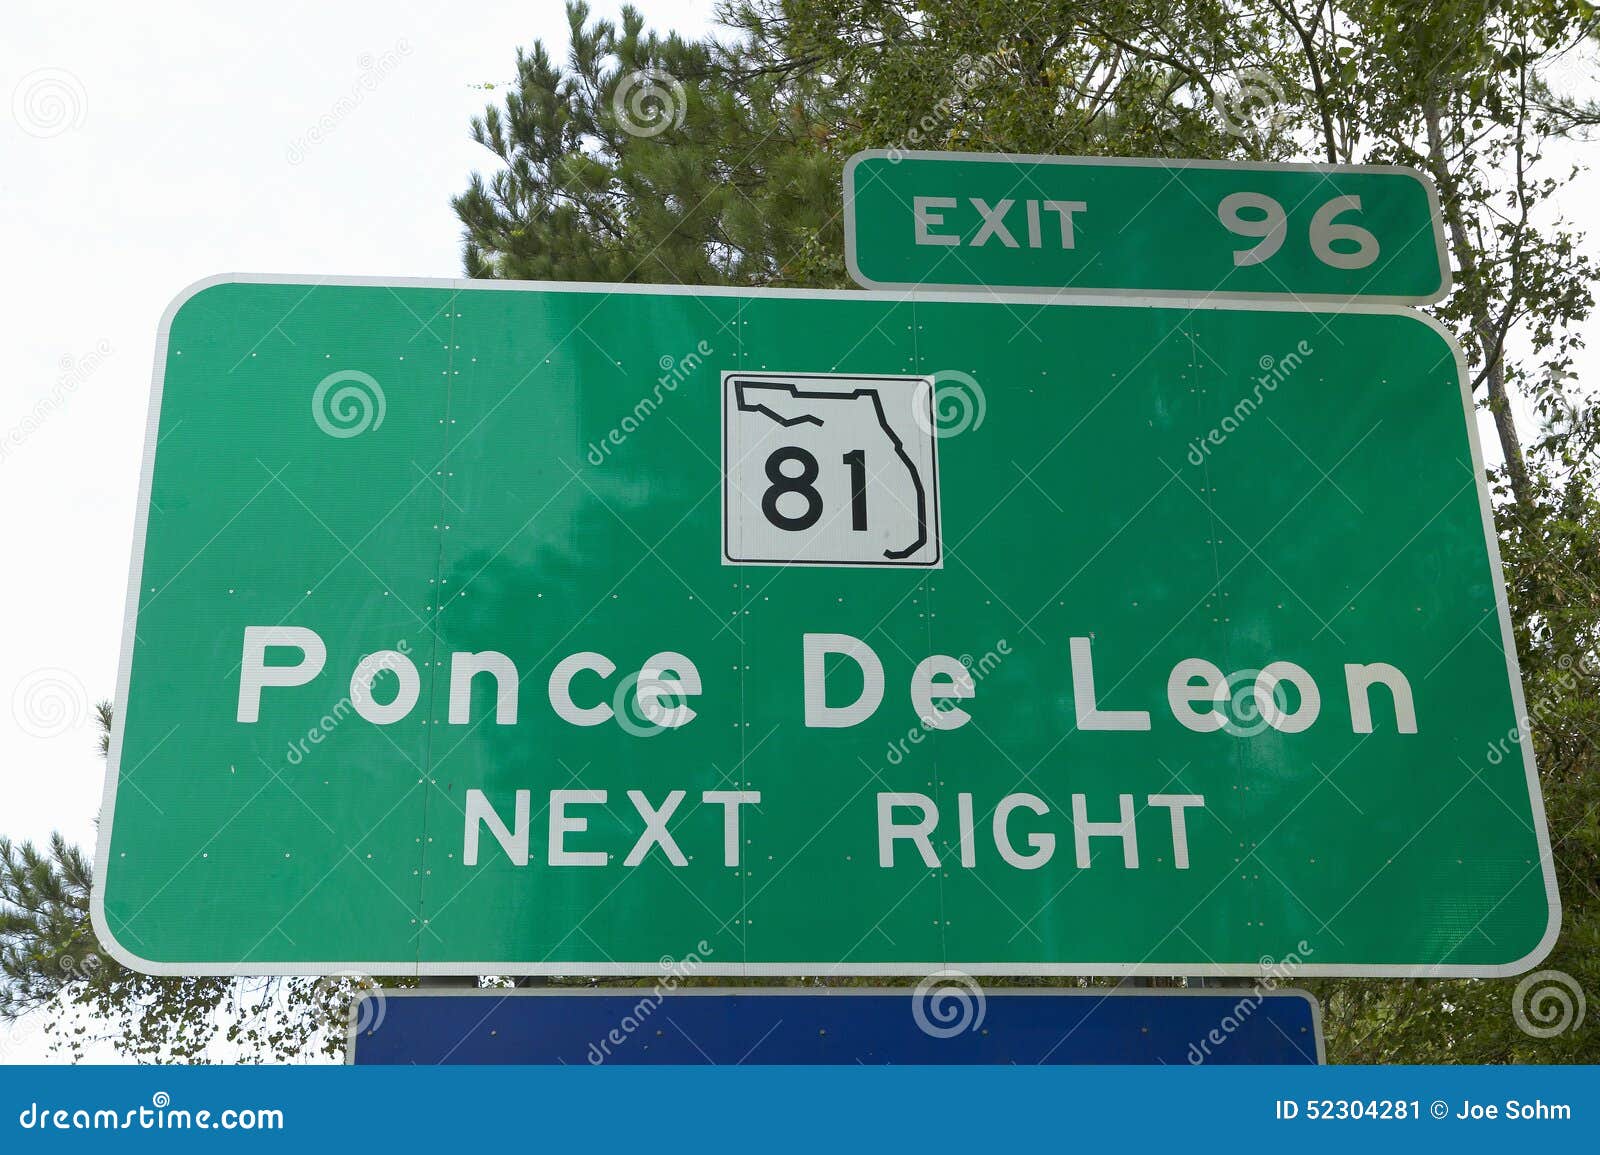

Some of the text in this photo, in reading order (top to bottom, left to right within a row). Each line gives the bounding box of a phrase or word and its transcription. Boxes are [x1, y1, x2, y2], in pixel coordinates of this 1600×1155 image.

[913, 192, 1380, 270] EXIT 96
[761, 446, 868, 532] 81
[236, 625, 1418, 734] Ponce De Leon
[463, 789, 1205, 870] NEXT RIGHT
